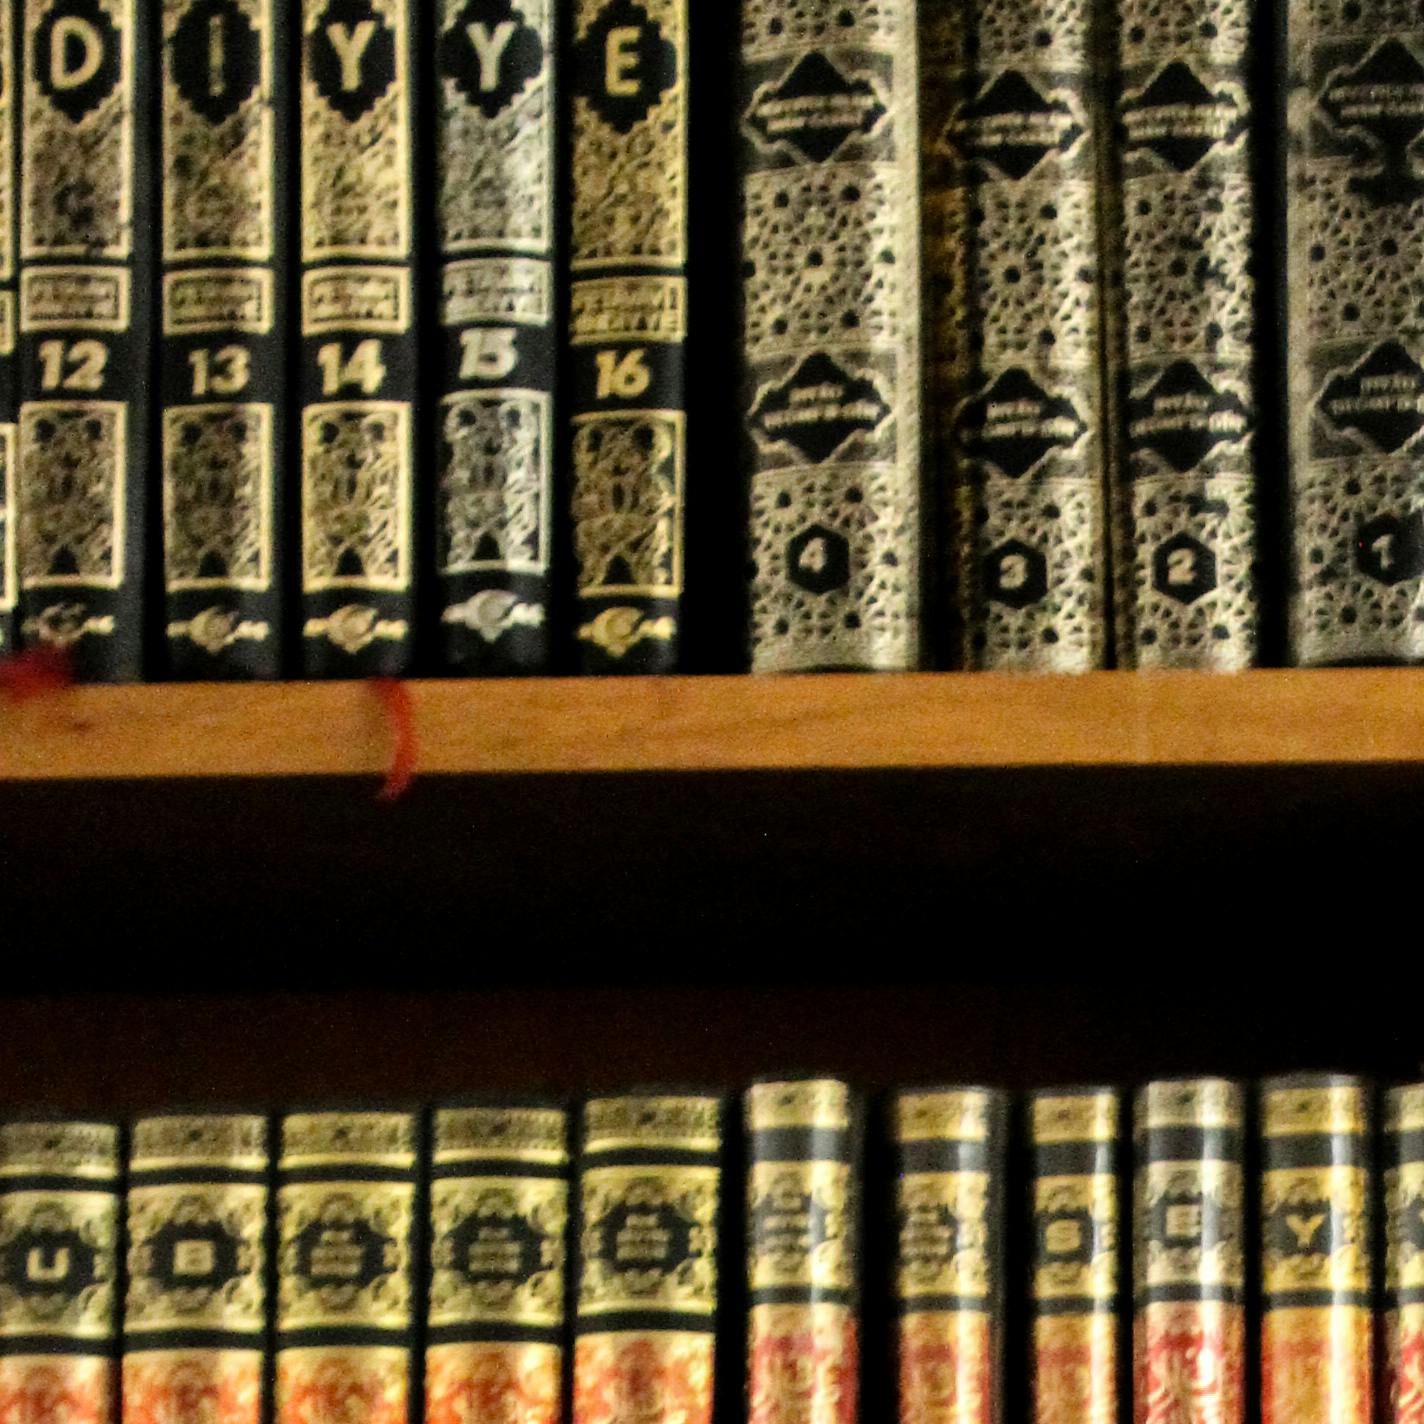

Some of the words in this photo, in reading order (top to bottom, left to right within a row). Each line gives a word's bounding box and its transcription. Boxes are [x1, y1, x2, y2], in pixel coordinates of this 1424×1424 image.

[50, 17, 100, 90] D
[331, 21, 375, 93] Y
[468, 22, 515, 93] Y
[605, 28, 640, 95] E
[38, 341, 110, 392] 12
[188, 348, 252, 394] 13
[317, 341, 387, 394] 14
[459, 328, 519, 382] 15
[595, 350, 652, 399] 16
[799, 538, 827, 573] 4
[1000, 554, 1028, 588] 3
[1166, 549, 1198, 584] 2
[1046, 1218, 1082, 1250] S
[1287, 1215, 1325, 1246] Y
[26, 1247, 70, 1281] U
